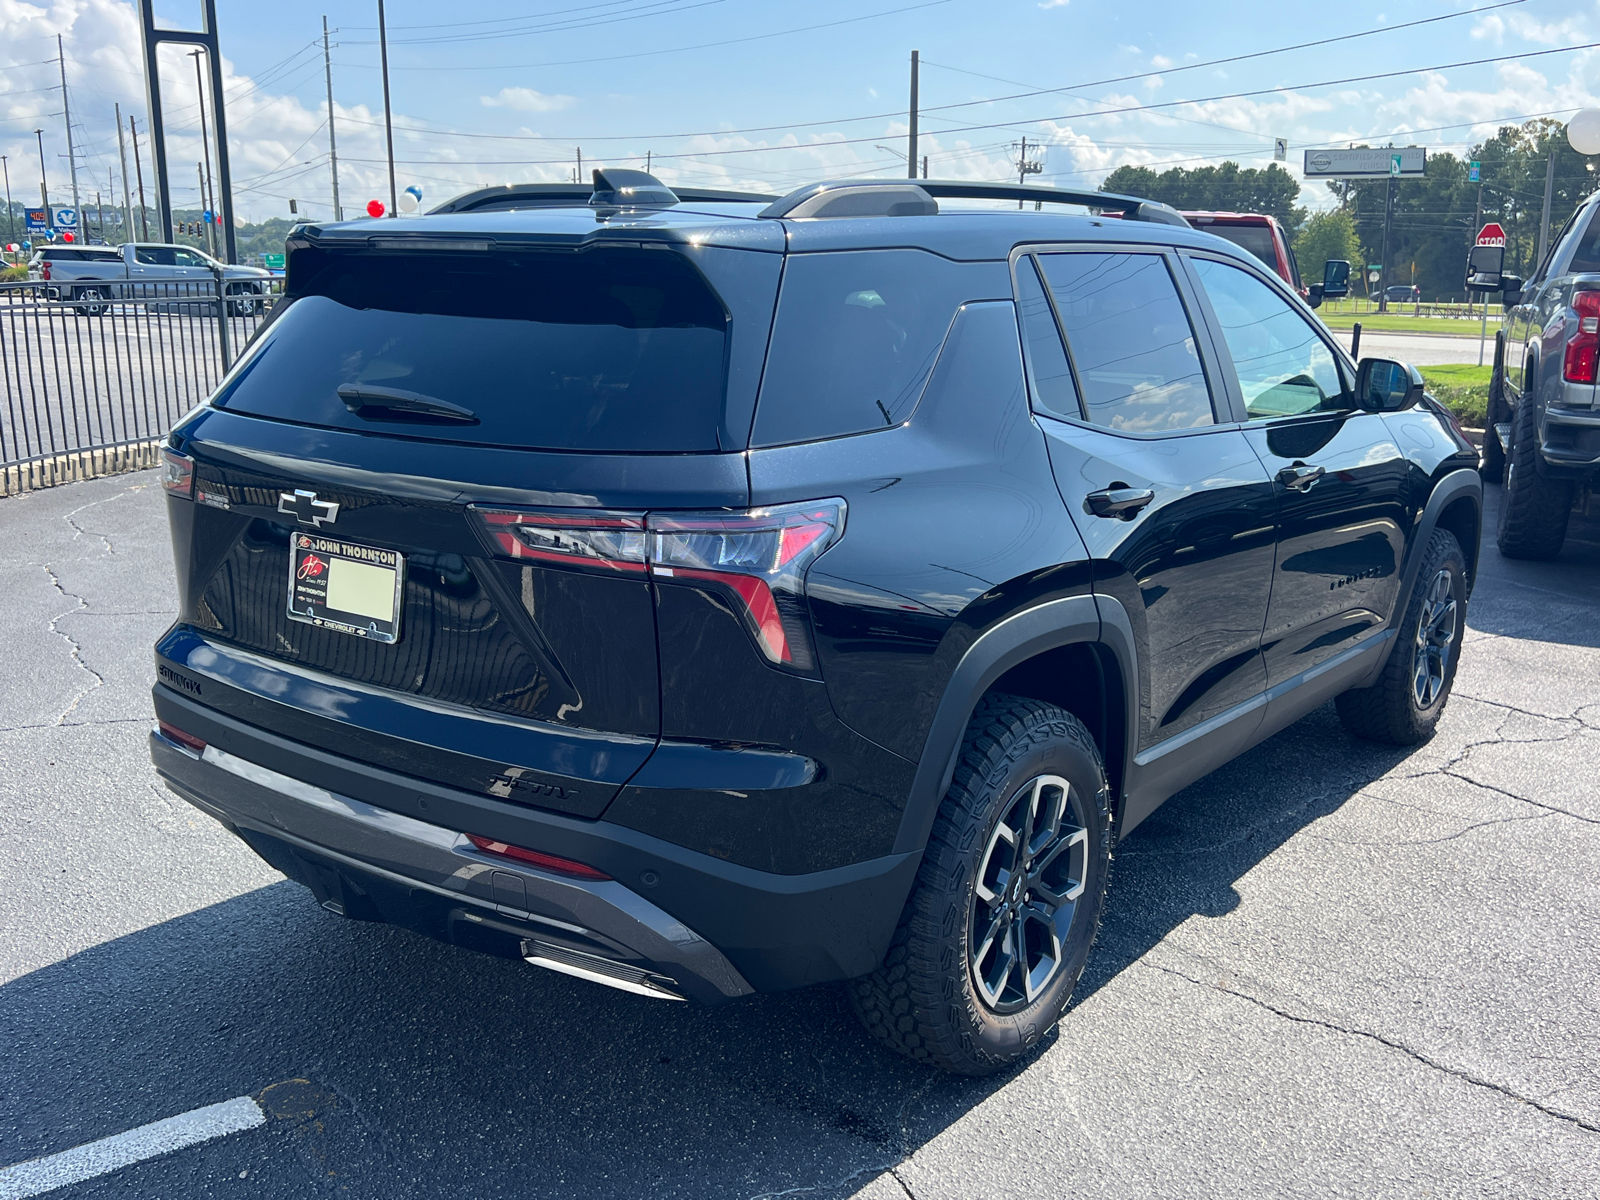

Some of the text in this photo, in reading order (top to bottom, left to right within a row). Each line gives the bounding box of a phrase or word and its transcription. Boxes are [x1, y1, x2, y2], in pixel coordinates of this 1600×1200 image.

[1333, 153, 1372, 161] CERTIFIED
[1359, 161, 1391, 170] VEHICLE
[1478, 236, 1503, 245] STOP
[316, 539, 340, 554] JOHN
[324, 621, 356, 634] CHEVROLET
[159, 664, 202, 695] EQUINOX
